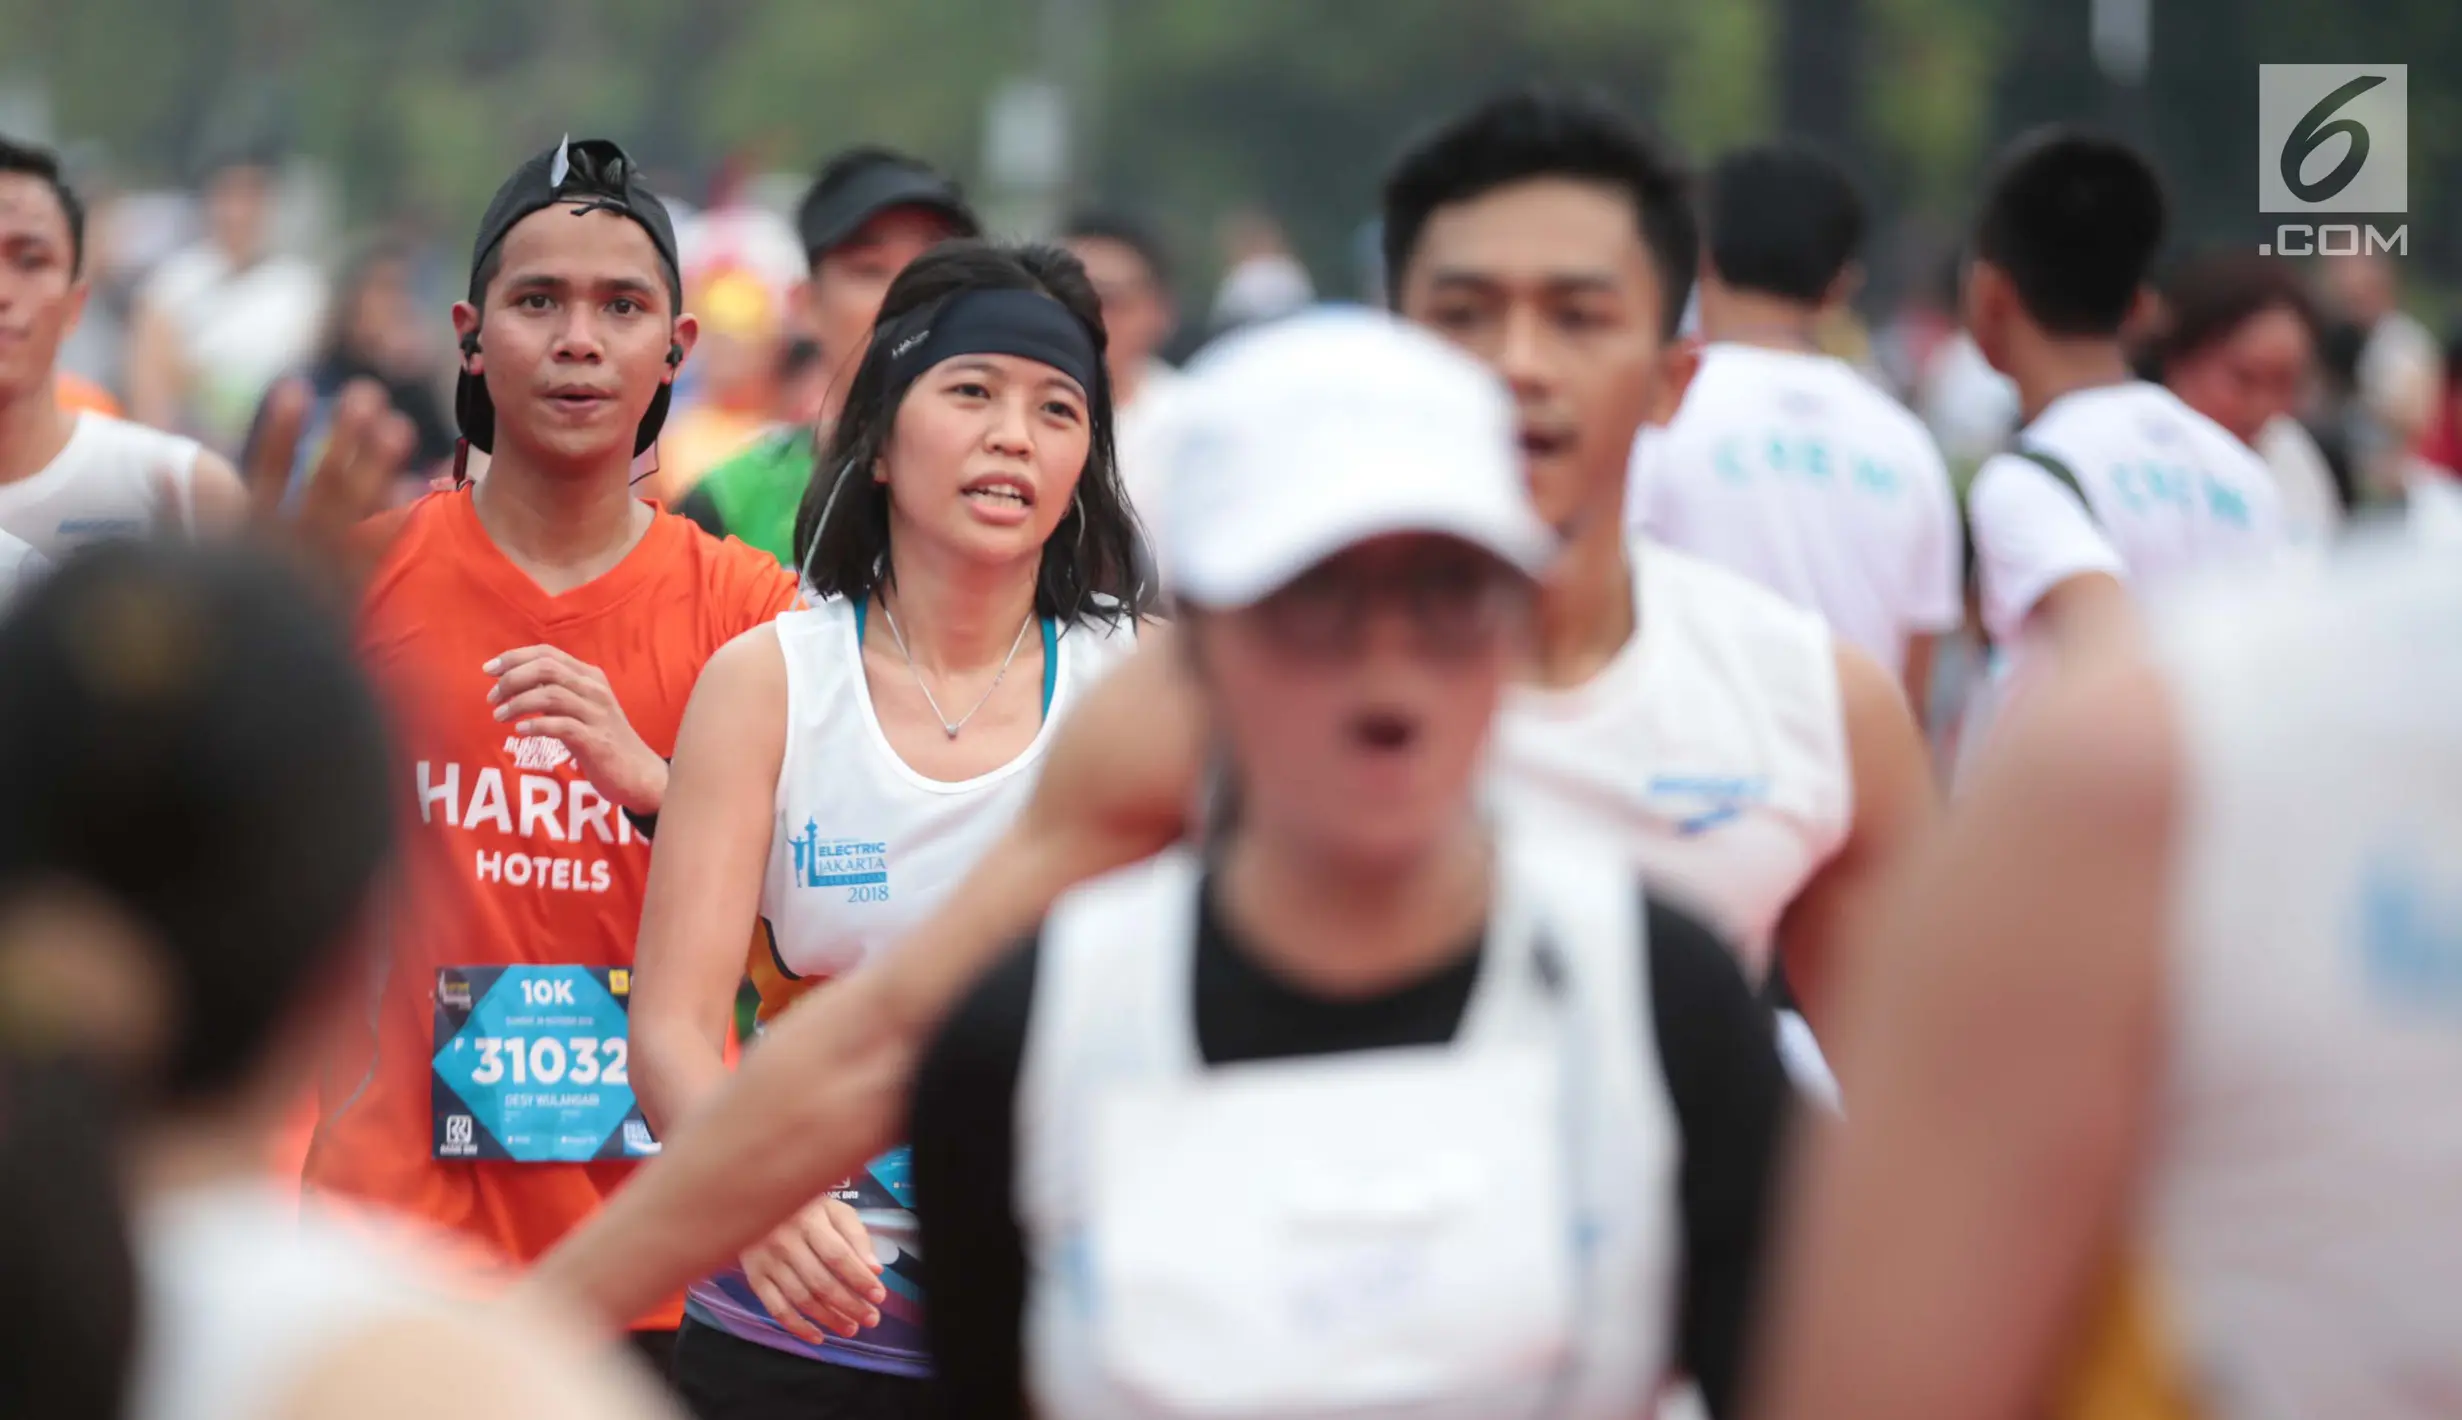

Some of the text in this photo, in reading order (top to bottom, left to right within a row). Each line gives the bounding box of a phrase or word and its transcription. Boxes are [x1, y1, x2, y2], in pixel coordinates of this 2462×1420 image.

[416, 760, 650, 846] HARRI
[818, 842, 886, 857] ELECTRIC
[476, 849, 611, 892] HOTELS
[819, 856, 888, 876] JAKARTA
[847, 885, 889, 903] 2018
[520, 979, 575, 1005] 10K
[471, 1036, 628, 1086] 31032
